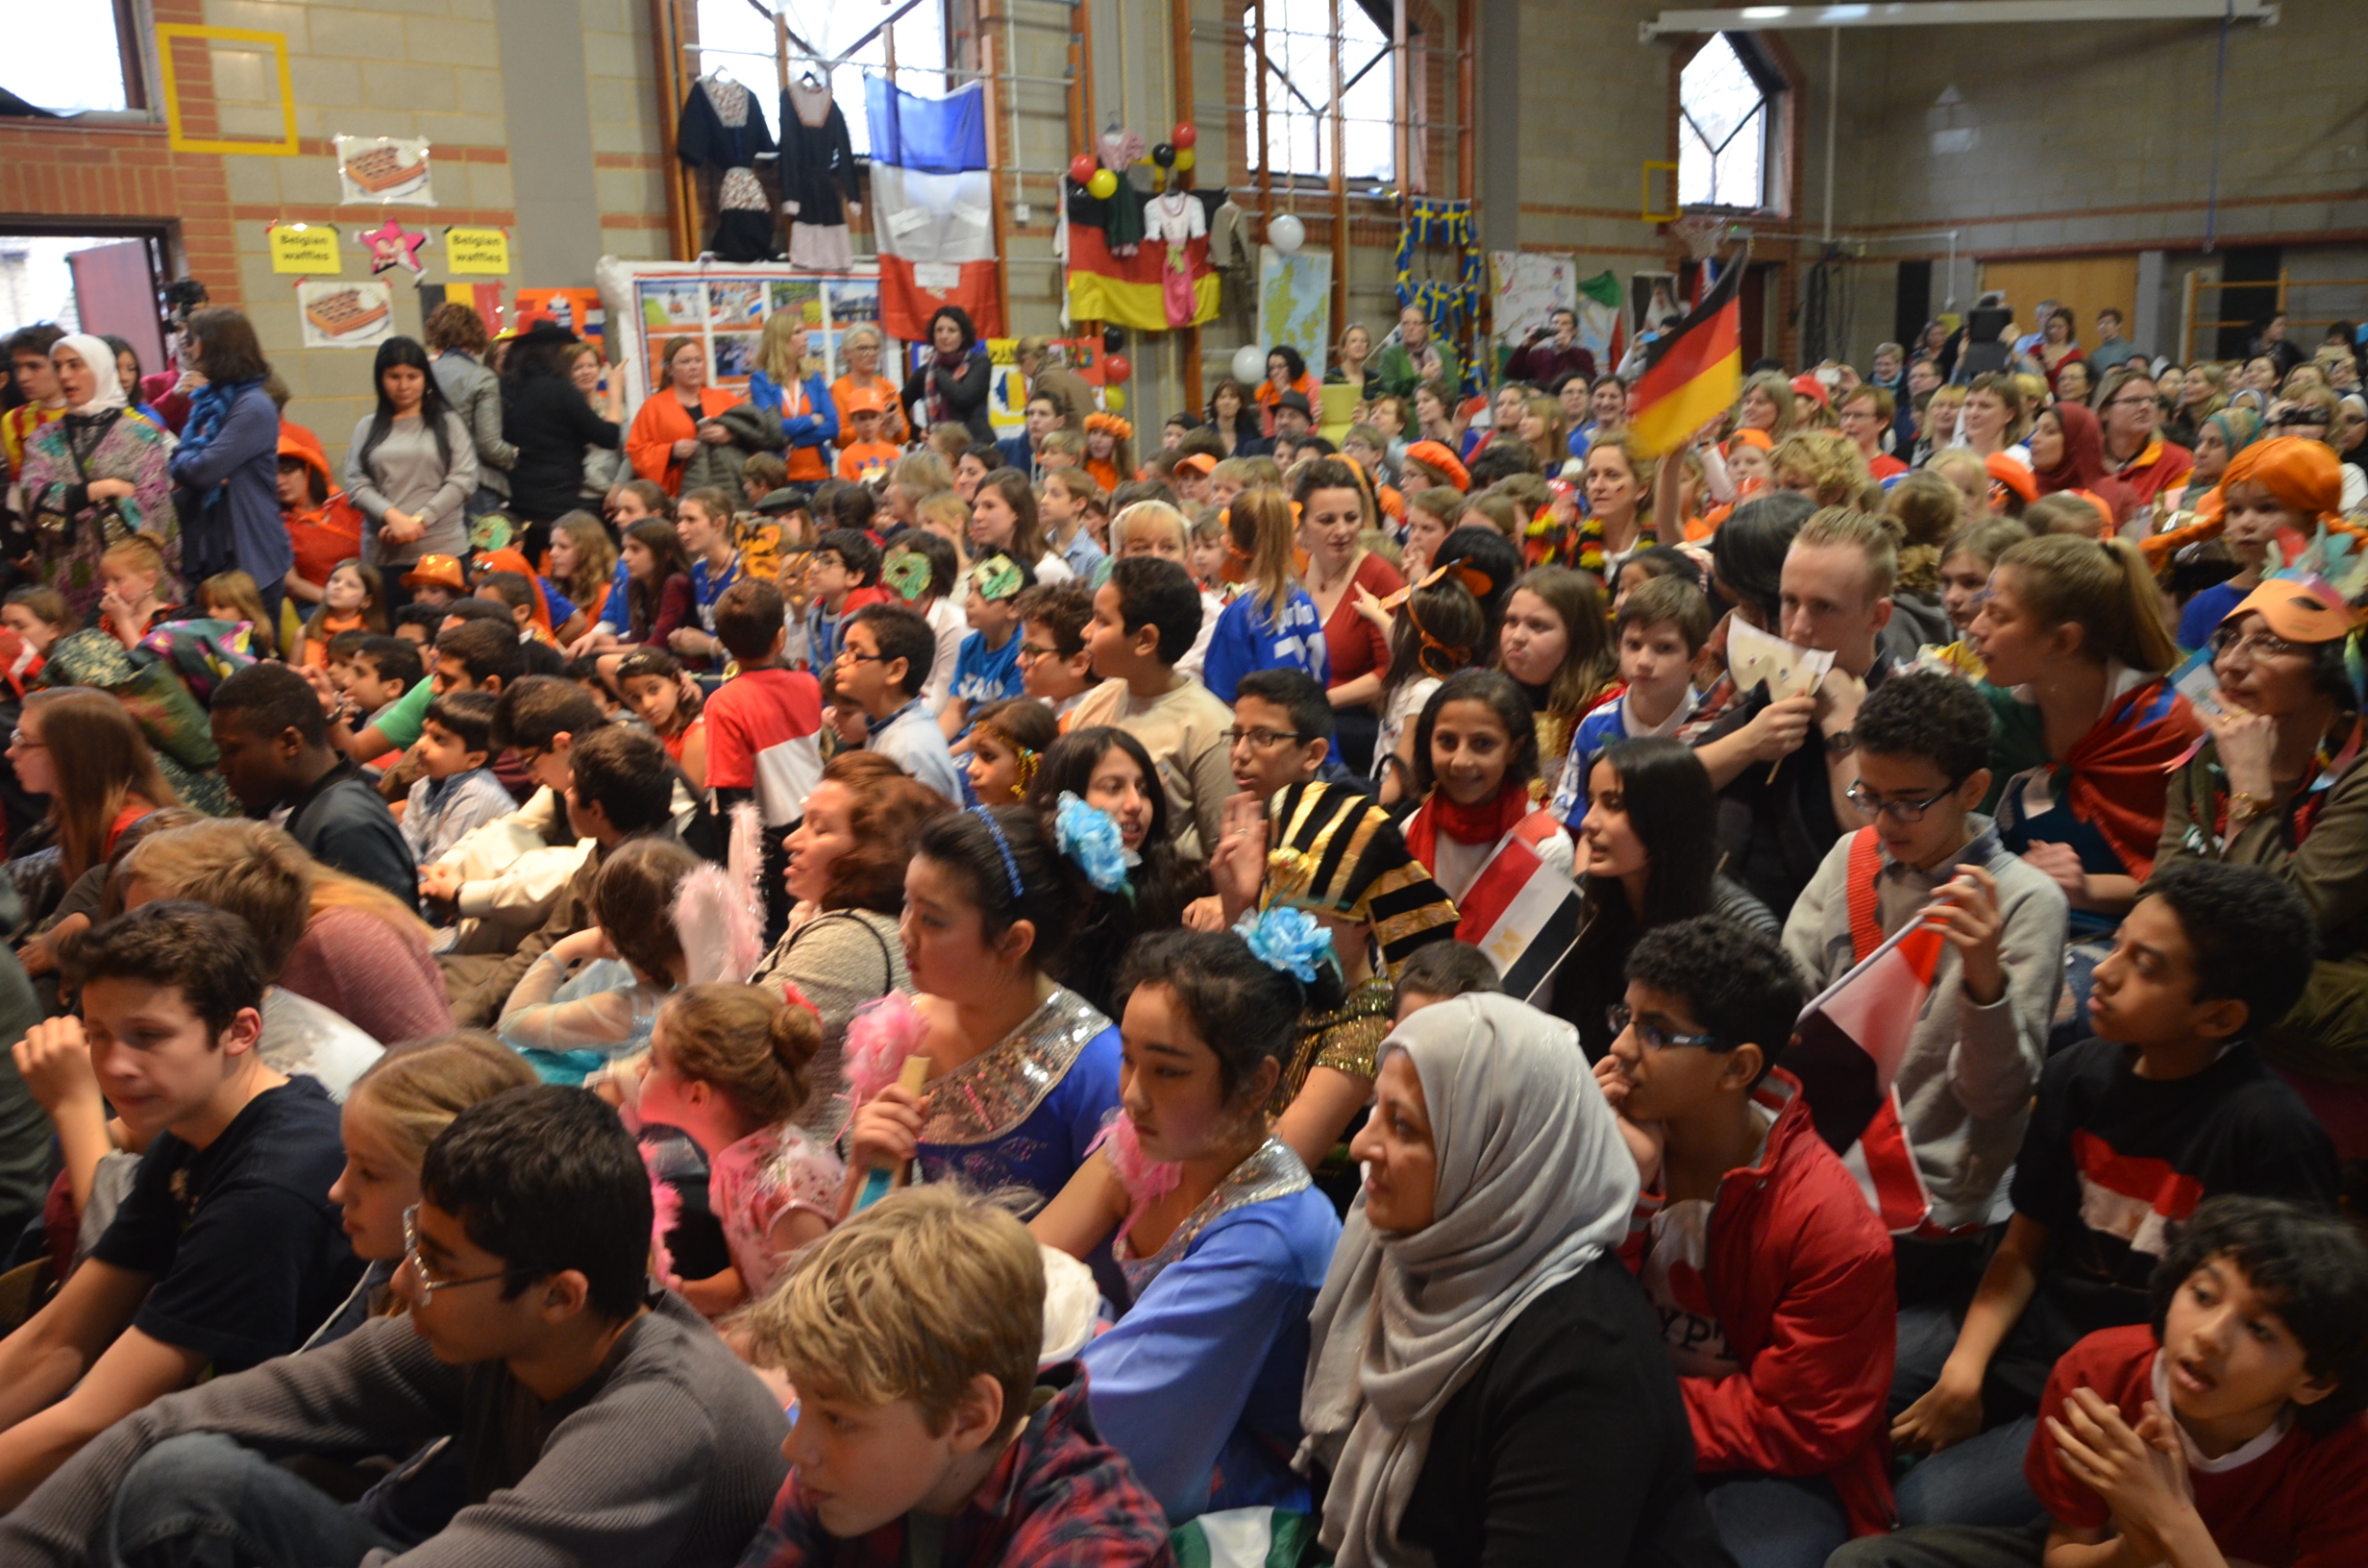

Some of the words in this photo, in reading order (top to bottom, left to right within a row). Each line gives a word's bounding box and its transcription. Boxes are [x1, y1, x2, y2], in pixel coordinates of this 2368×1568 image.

[280, 234, 329, 247] Belgian
[452, 234, 502, 248] Belgian
[282, 250, 330, 260] waffles
[455, 251, 503, 262] waffles
[1655, 1305, 1736, 1360] YPT
